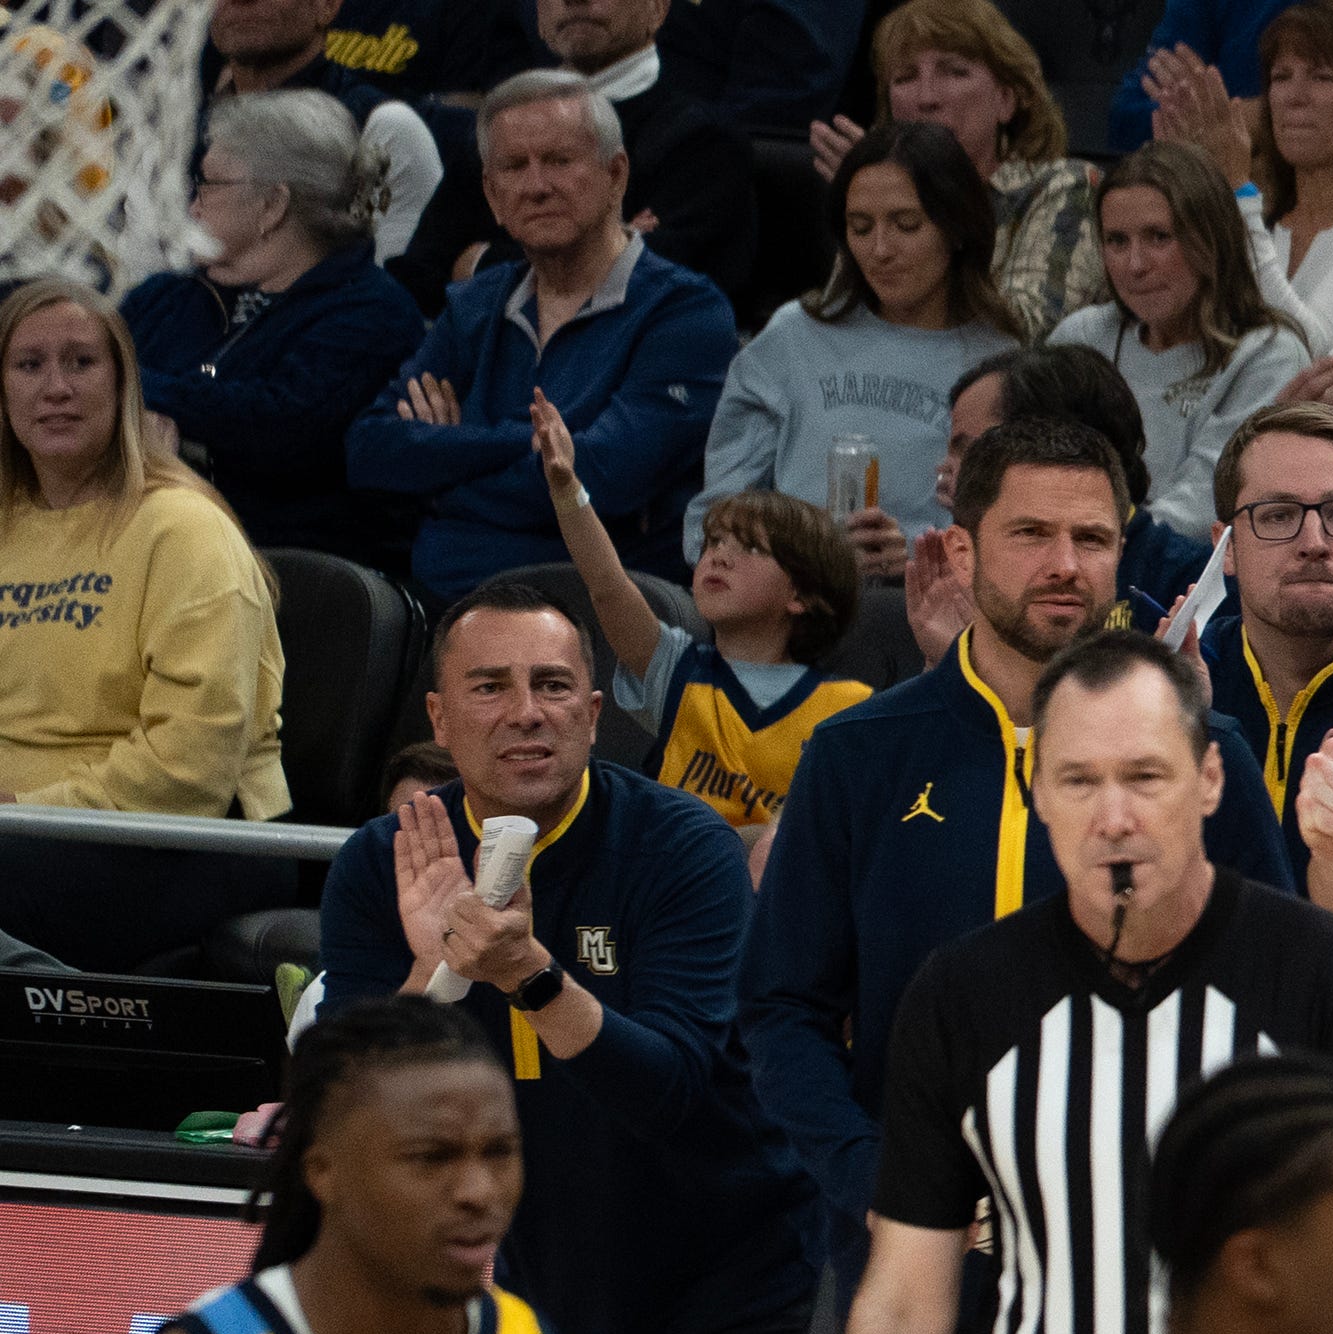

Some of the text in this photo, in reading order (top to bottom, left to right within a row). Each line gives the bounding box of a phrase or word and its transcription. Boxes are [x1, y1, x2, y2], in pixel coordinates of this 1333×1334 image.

[0, 571, 113, 607] rquette
[677, 748, 786, 818] Marqu
[575, 926, 619, 975] MU
